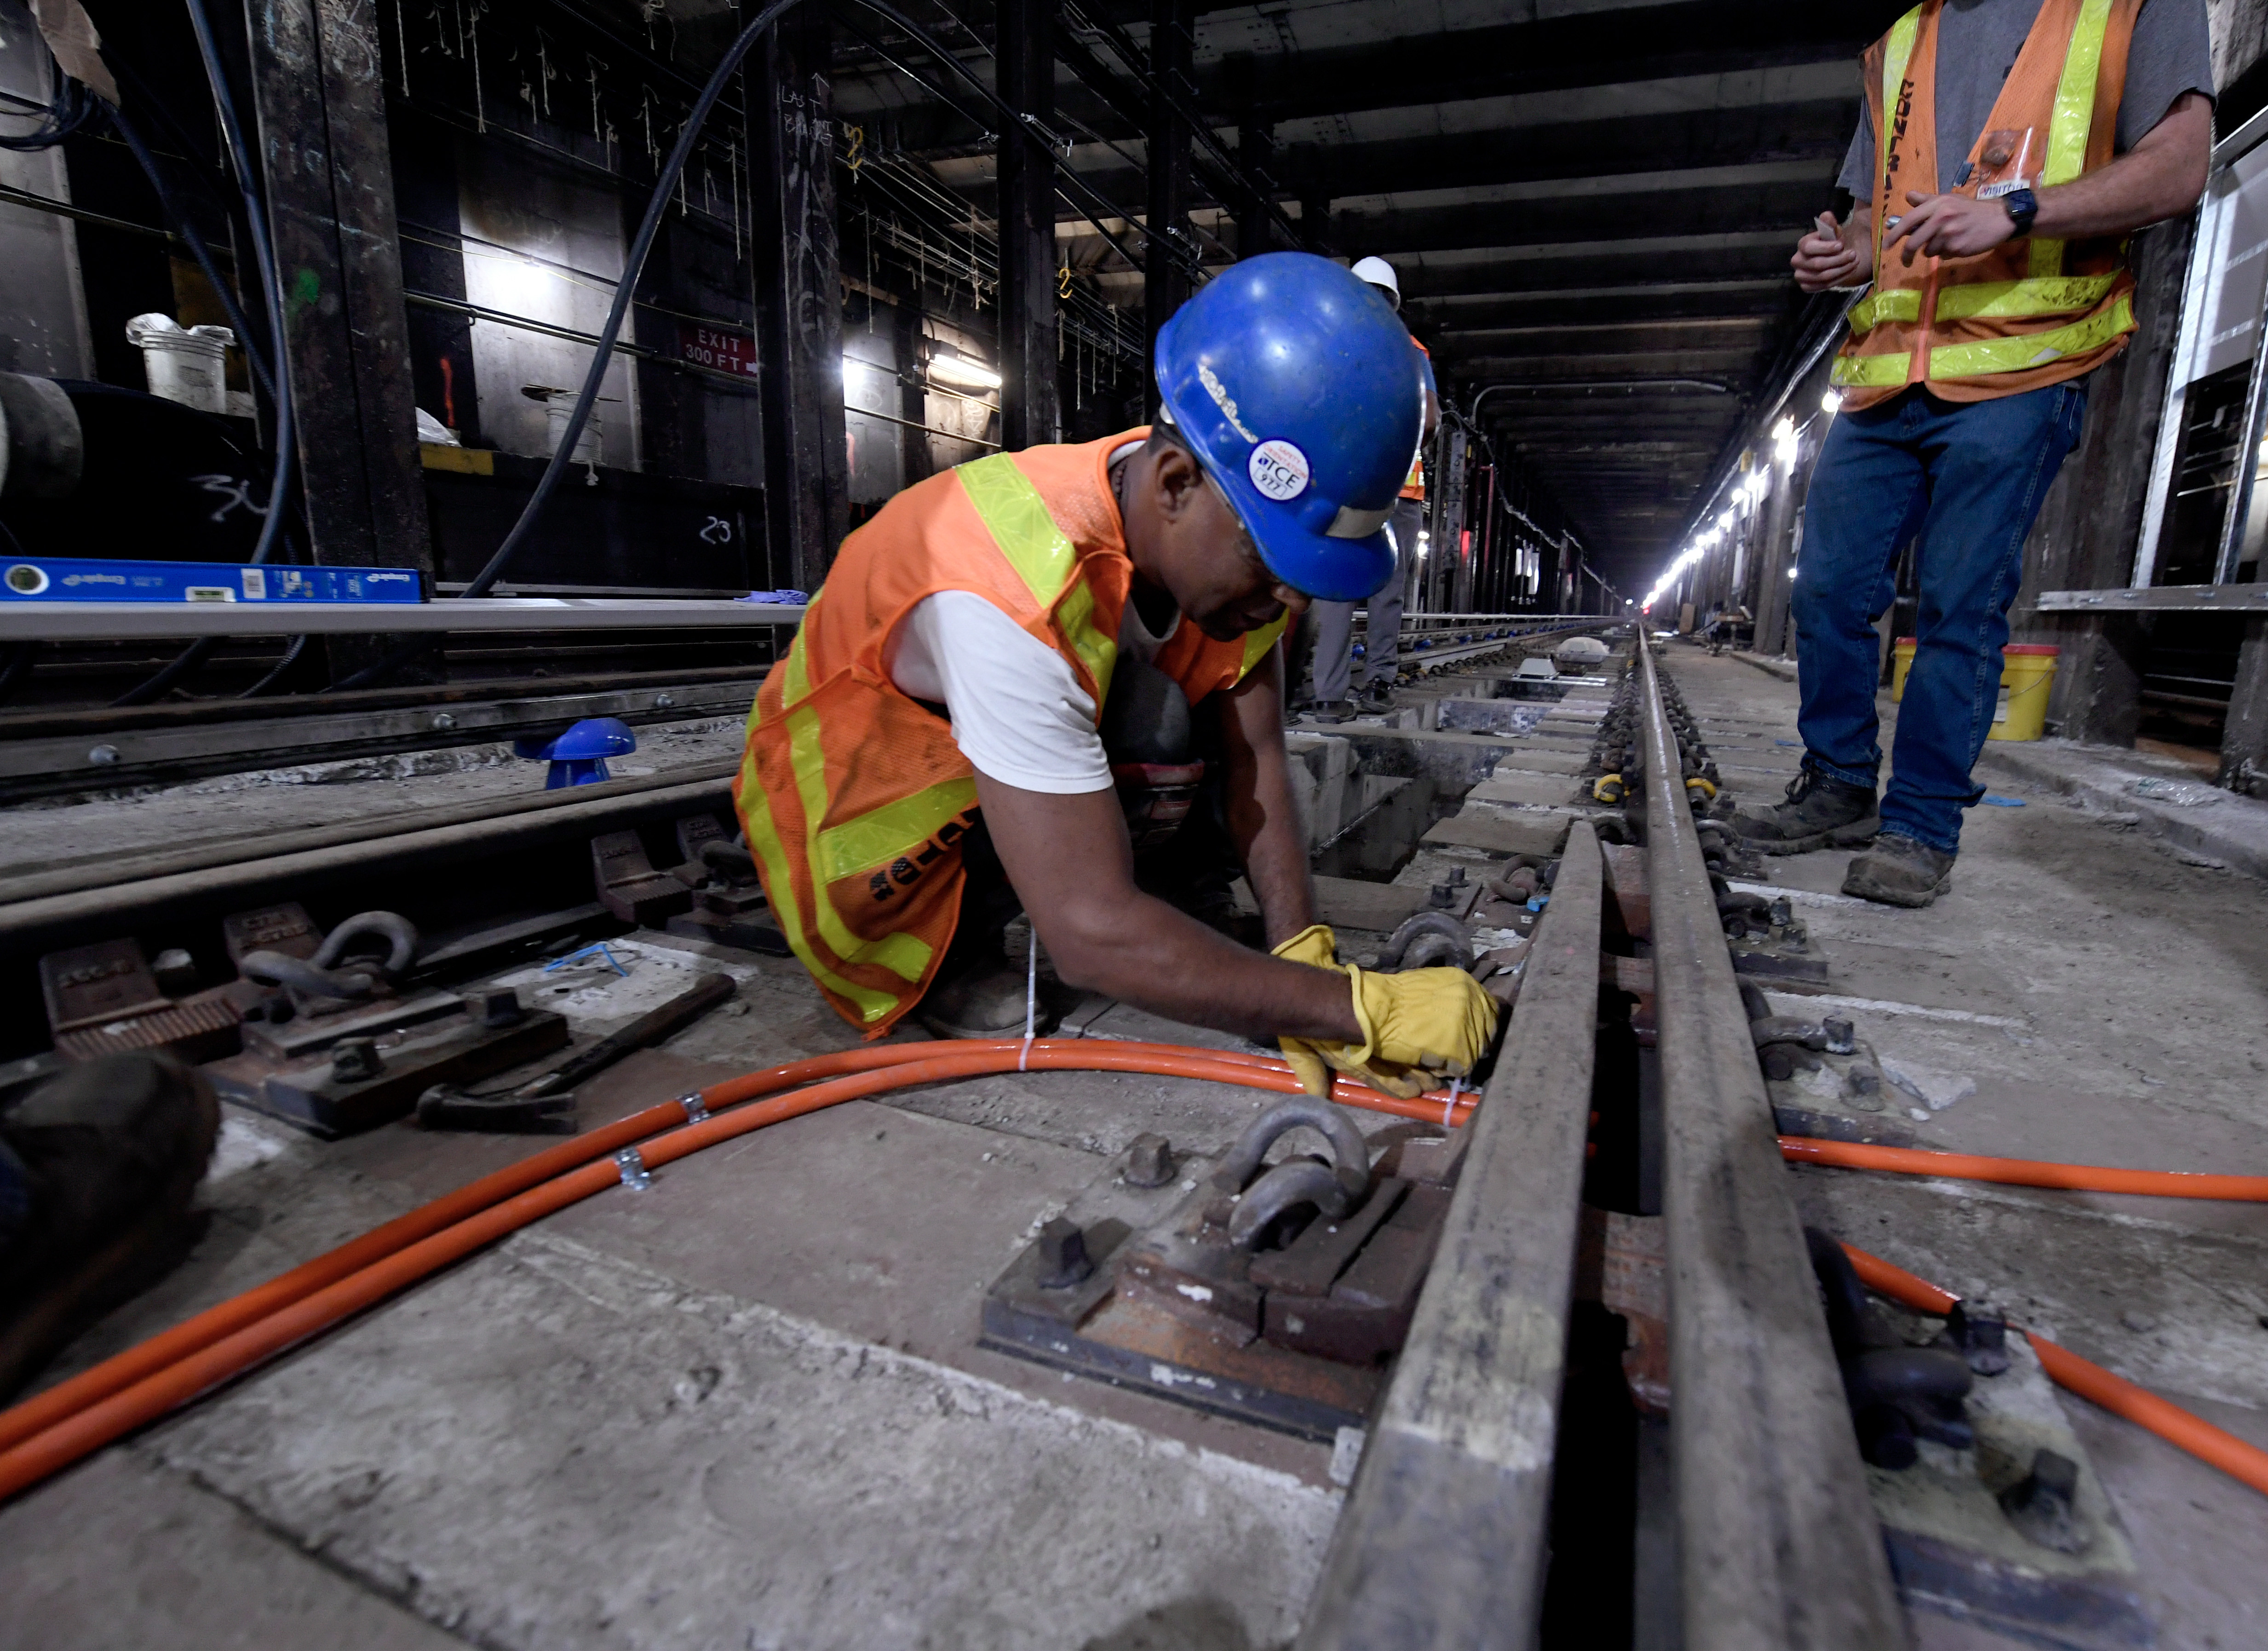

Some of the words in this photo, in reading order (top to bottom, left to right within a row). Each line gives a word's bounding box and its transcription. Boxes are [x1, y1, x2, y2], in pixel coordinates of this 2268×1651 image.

[699, 329, 740, 352] EXIT
[686, 344, 712, 364] 300
[718, 353, 740, 371] FT
[1261, 474, 1280, 490] 977
[1263, 452, 1300, 488] TCE
